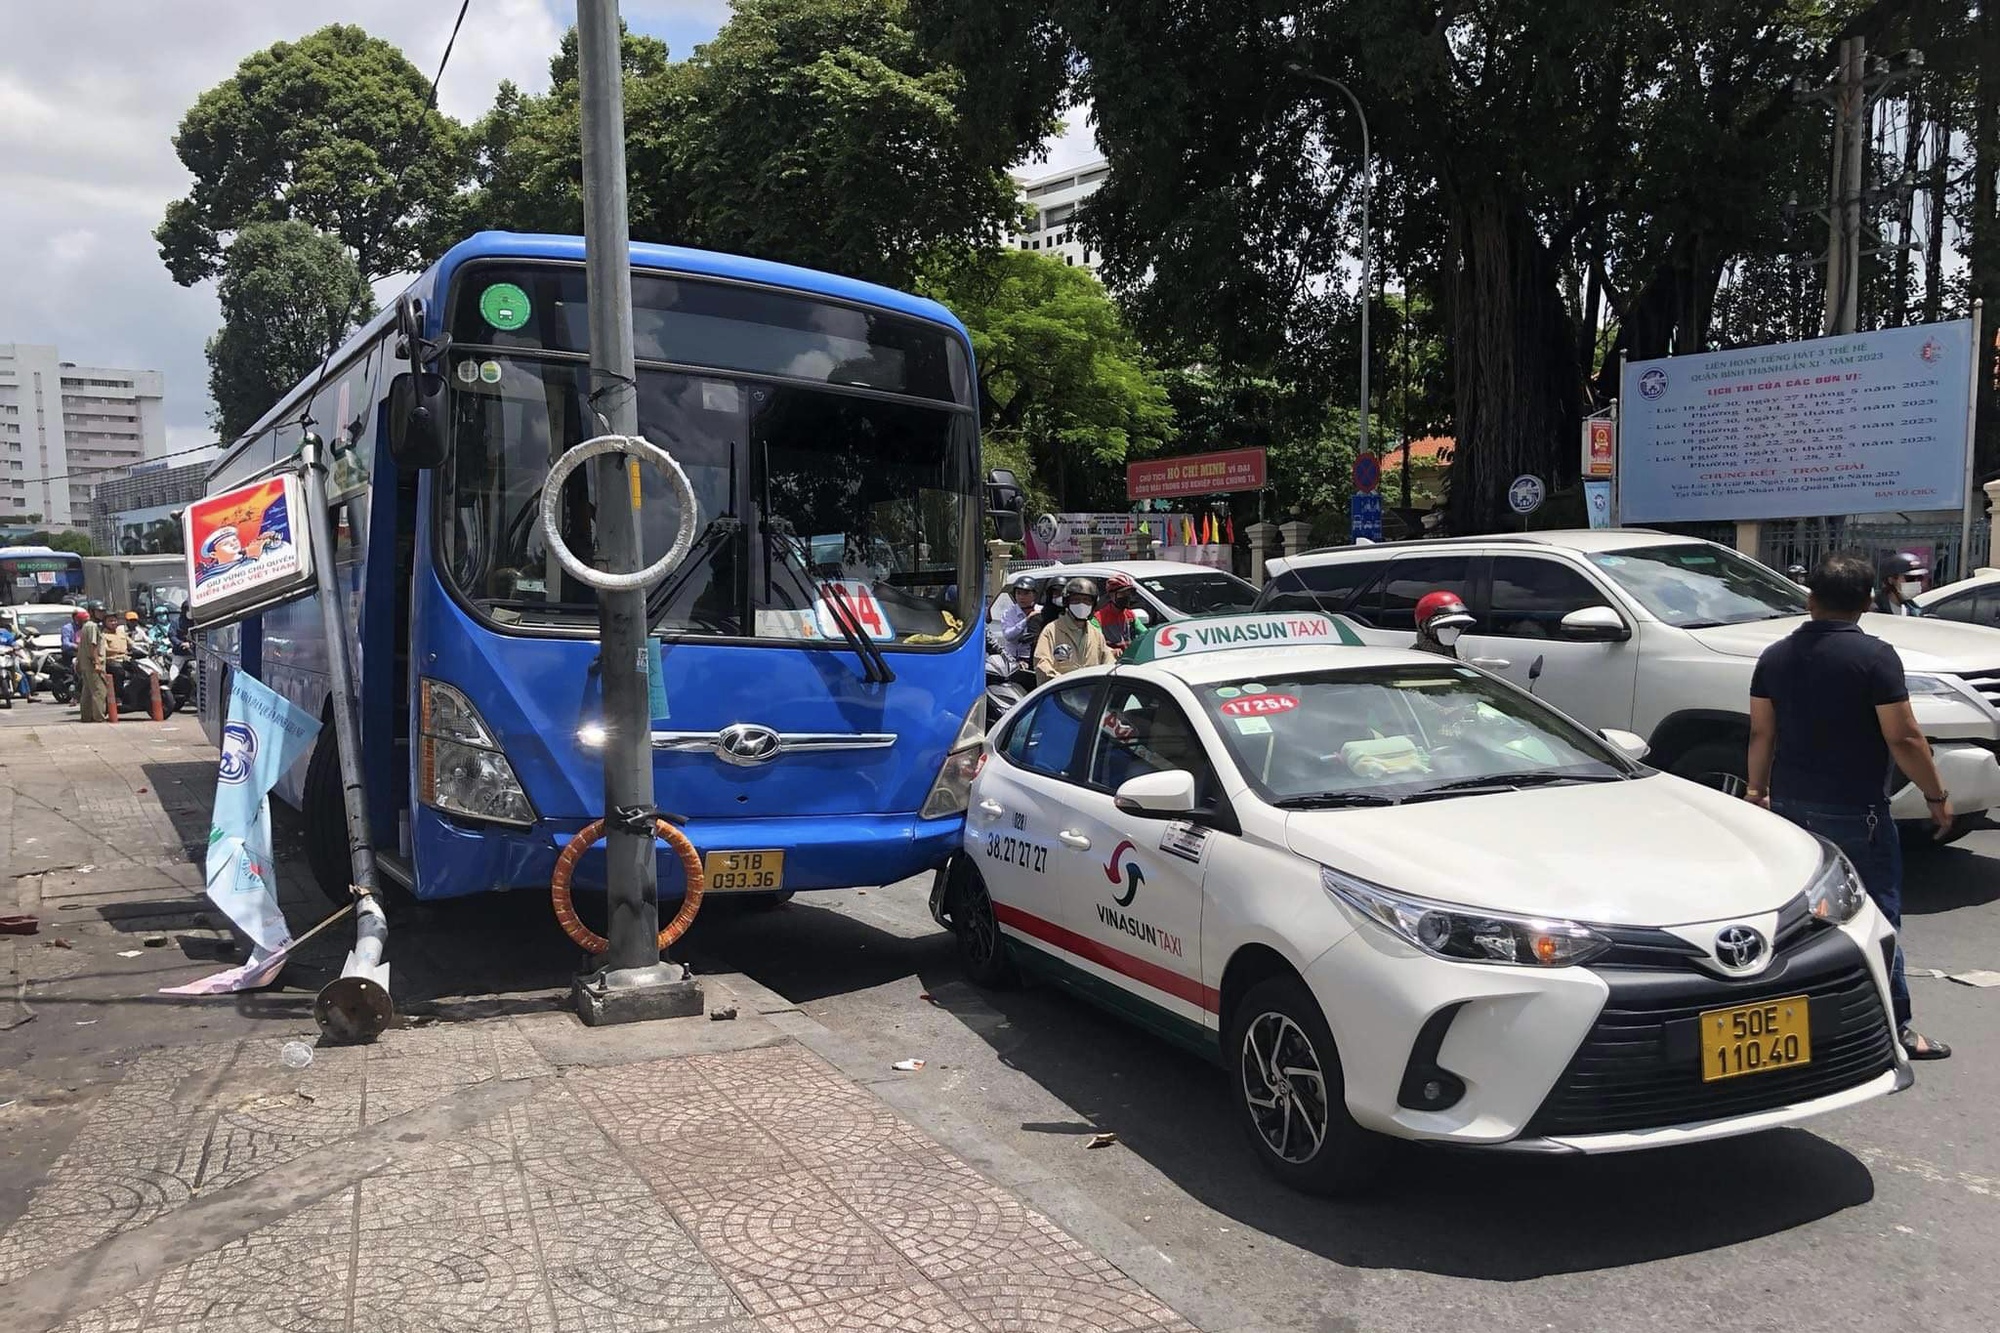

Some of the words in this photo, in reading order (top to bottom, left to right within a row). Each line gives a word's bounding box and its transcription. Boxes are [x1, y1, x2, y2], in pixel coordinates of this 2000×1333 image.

[1200, 461, 1226, 476] MINH
[267, 556, 294, 568] QUYỀN
[272, 562, 296, 573] NAM
[1195, 622, 1287, 645] VINASUN
[1287, 620, 1328, 638] TAXI
[1227, 697, 1294, 714] 17254
[729, 854, 762, 870] 51B
[987, 832, 1016, 864] 38.27
[1018, 840, 1031, 868] 27
[1034, 845, 1047, 874] 27
[713, 871, 774, 889] 093.36
[1096, 903, 1156, 946] VINASUN
[1156, 929, 1183, 957] TAXI
[1732, 1005, 1778, 1039] 50E
[1718, 1034, 1798, 1073] 110.40
